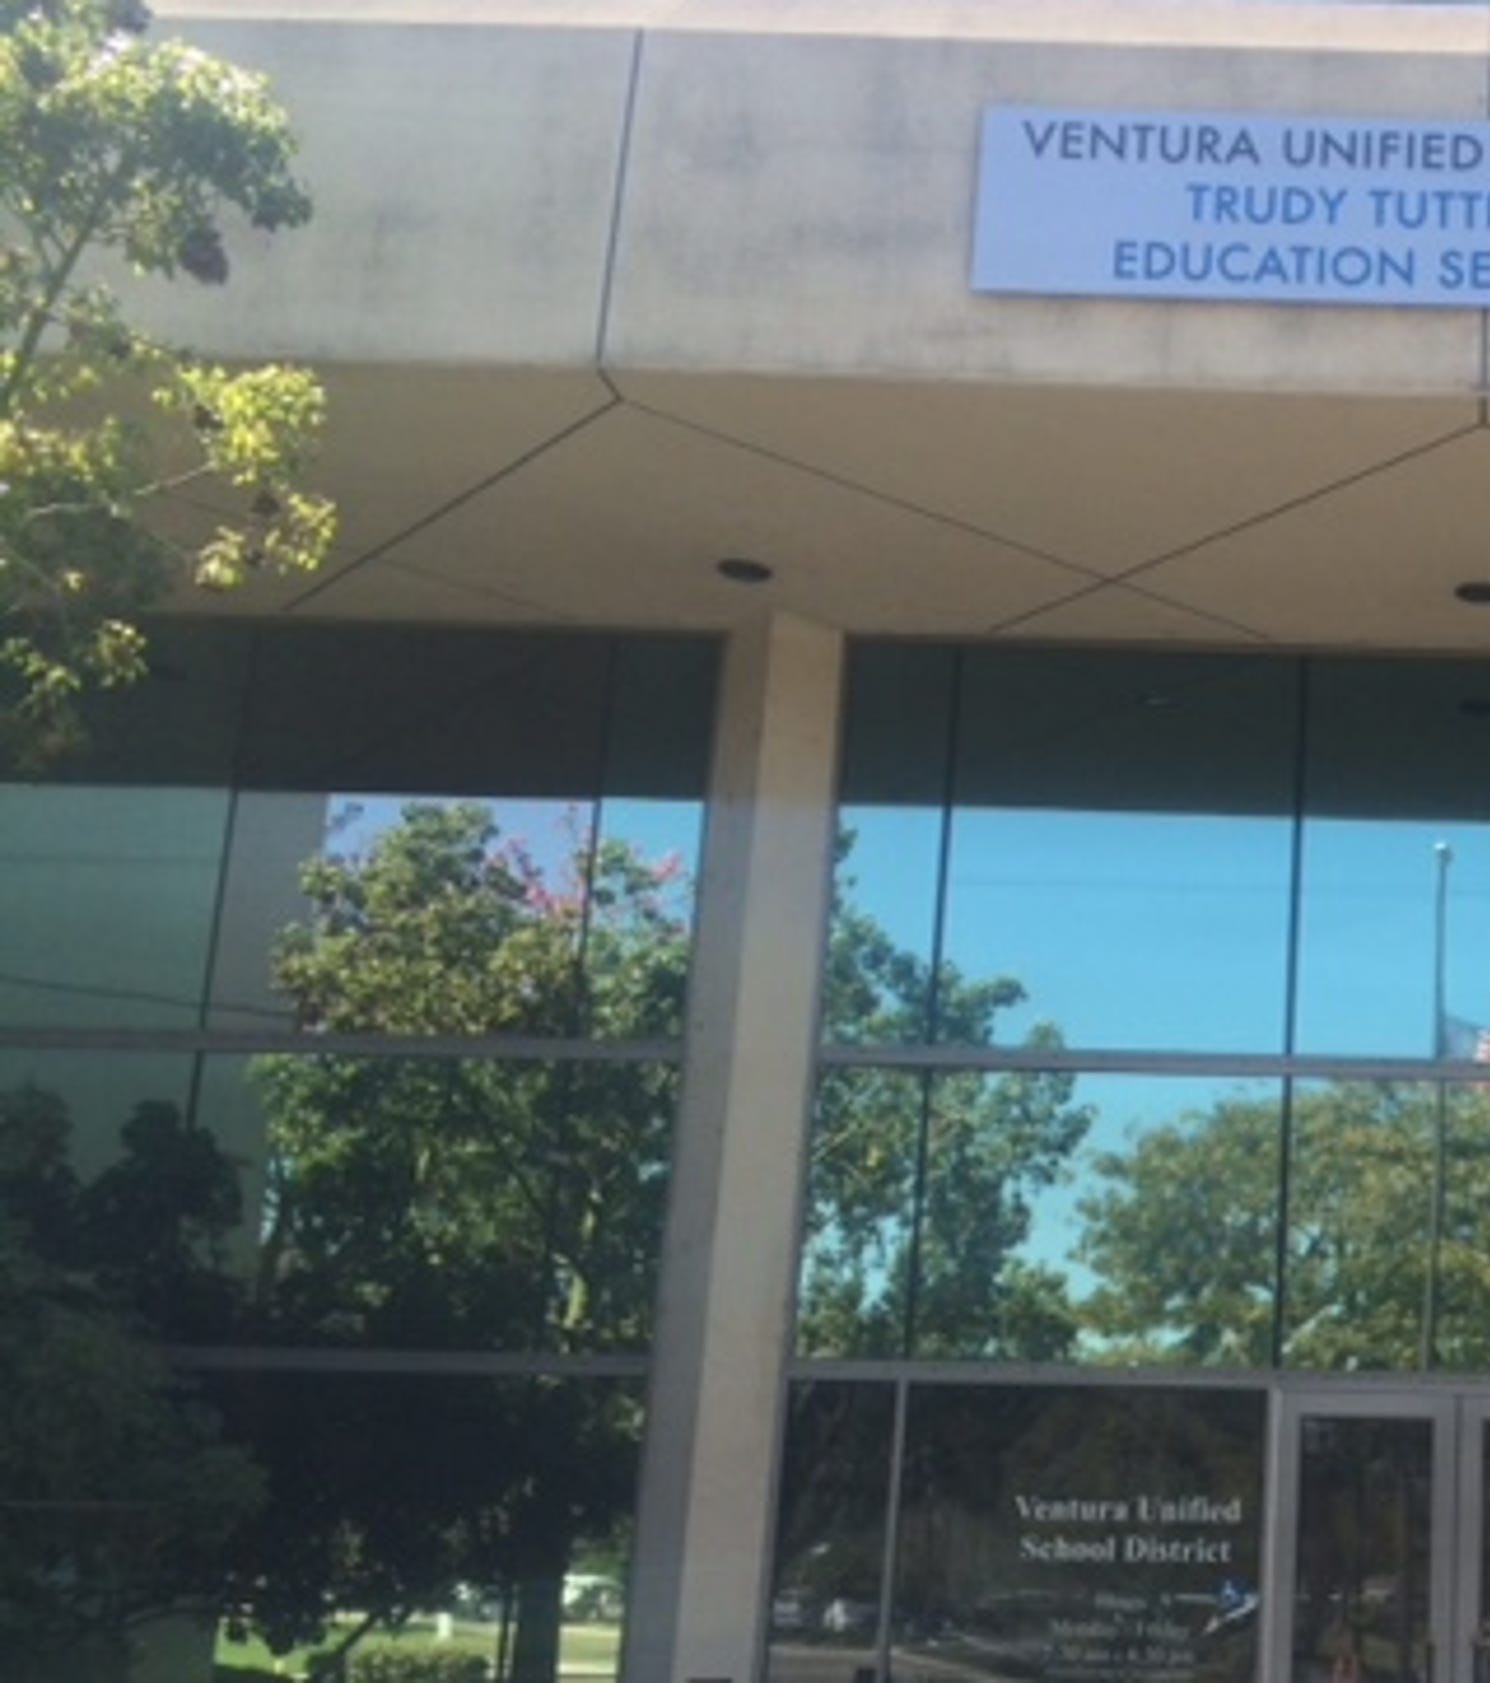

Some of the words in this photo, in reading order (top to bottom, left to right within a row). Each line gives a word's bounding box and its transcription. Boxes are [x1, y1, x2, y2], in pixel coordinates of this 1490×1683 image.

[1023, 120, 1259, 165] VENTURA
[1283, 128, 1483, 172] UNIFIED
[1186, 184, 1347, 226] TRUDY
[1113, 241, 1414, 287] EDUCATION
[1014, 1495, 1129, 1522] Ventura
[1137, 1496, 1242, 1523] Unified
[1021, 1535, 1115, 1563] School
[1123, 1536, 1231, 1563] District
